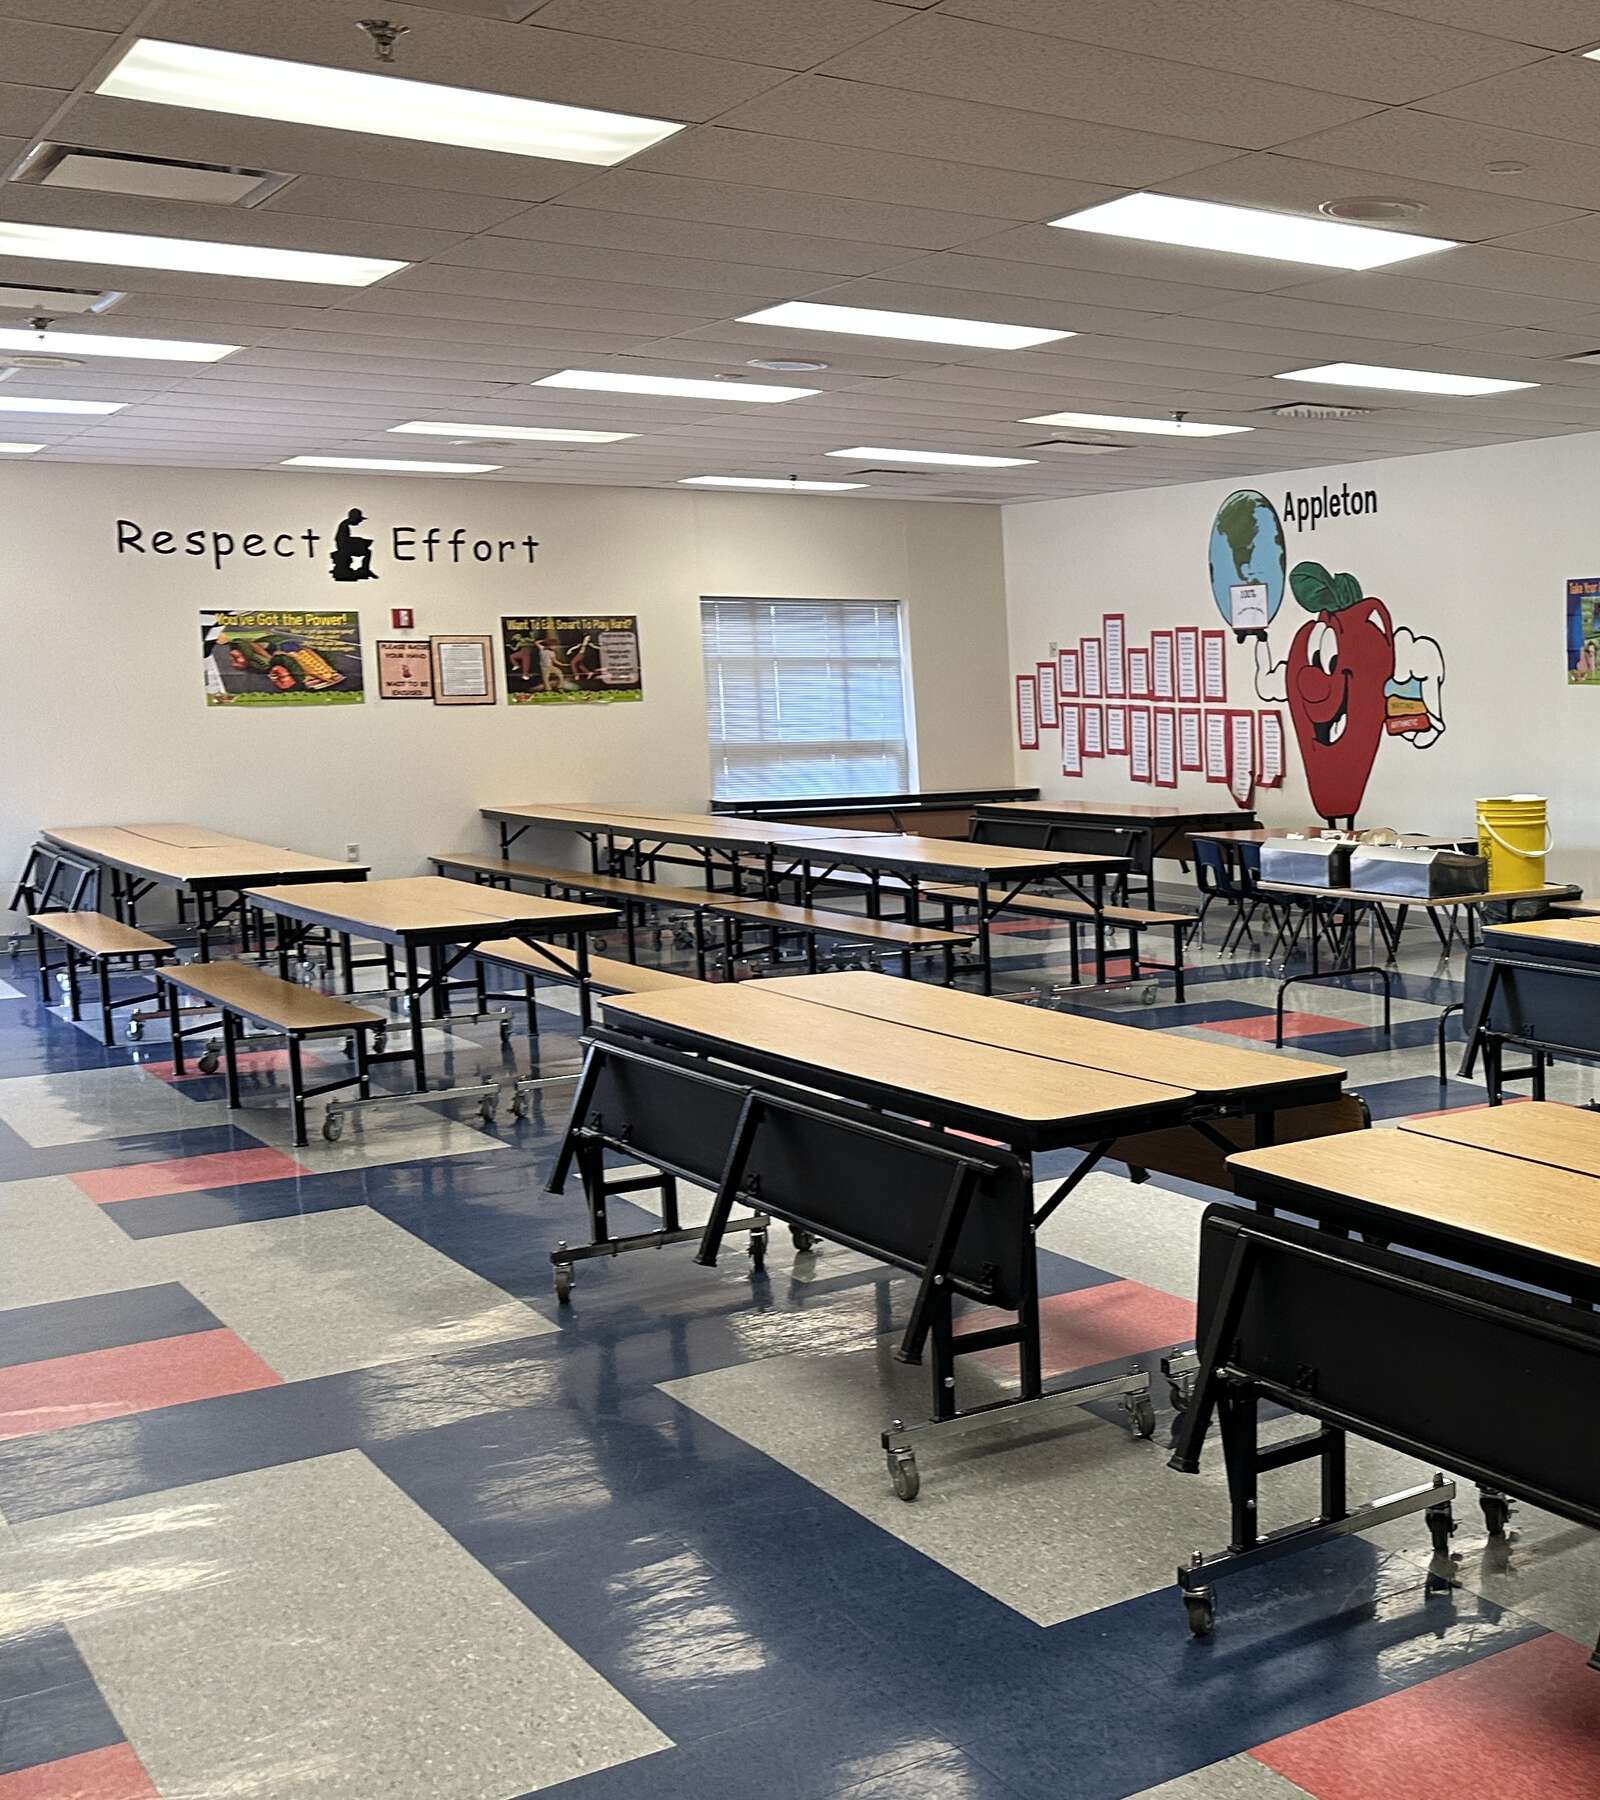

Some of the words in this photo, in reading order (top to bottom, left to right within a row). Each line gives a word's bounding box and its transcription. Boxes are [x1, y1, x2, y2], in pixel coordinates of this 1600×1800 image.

[1283, 482, 1378, 533] Appleton
[117, 519, 321, 570] Respect
[392, 527, 540, 563] Effort
[1568, 582, 1583, 594] Take
[1583, 582, 1598, 593] Your
[215, 613, 255, 625] You've
[256, 613, 280, 626] Got
[282, 613, 303, 626] the
[304, 614, 347, 626] Power!
[506, 620, 530, 630] Want
[530, 619, 540, 630] To
[541, 619, 556, 630] Eat
[556, 619, 581, 630] Smart
[582, 619, 591, 630] To
[592, 619, 610, 632] Play
